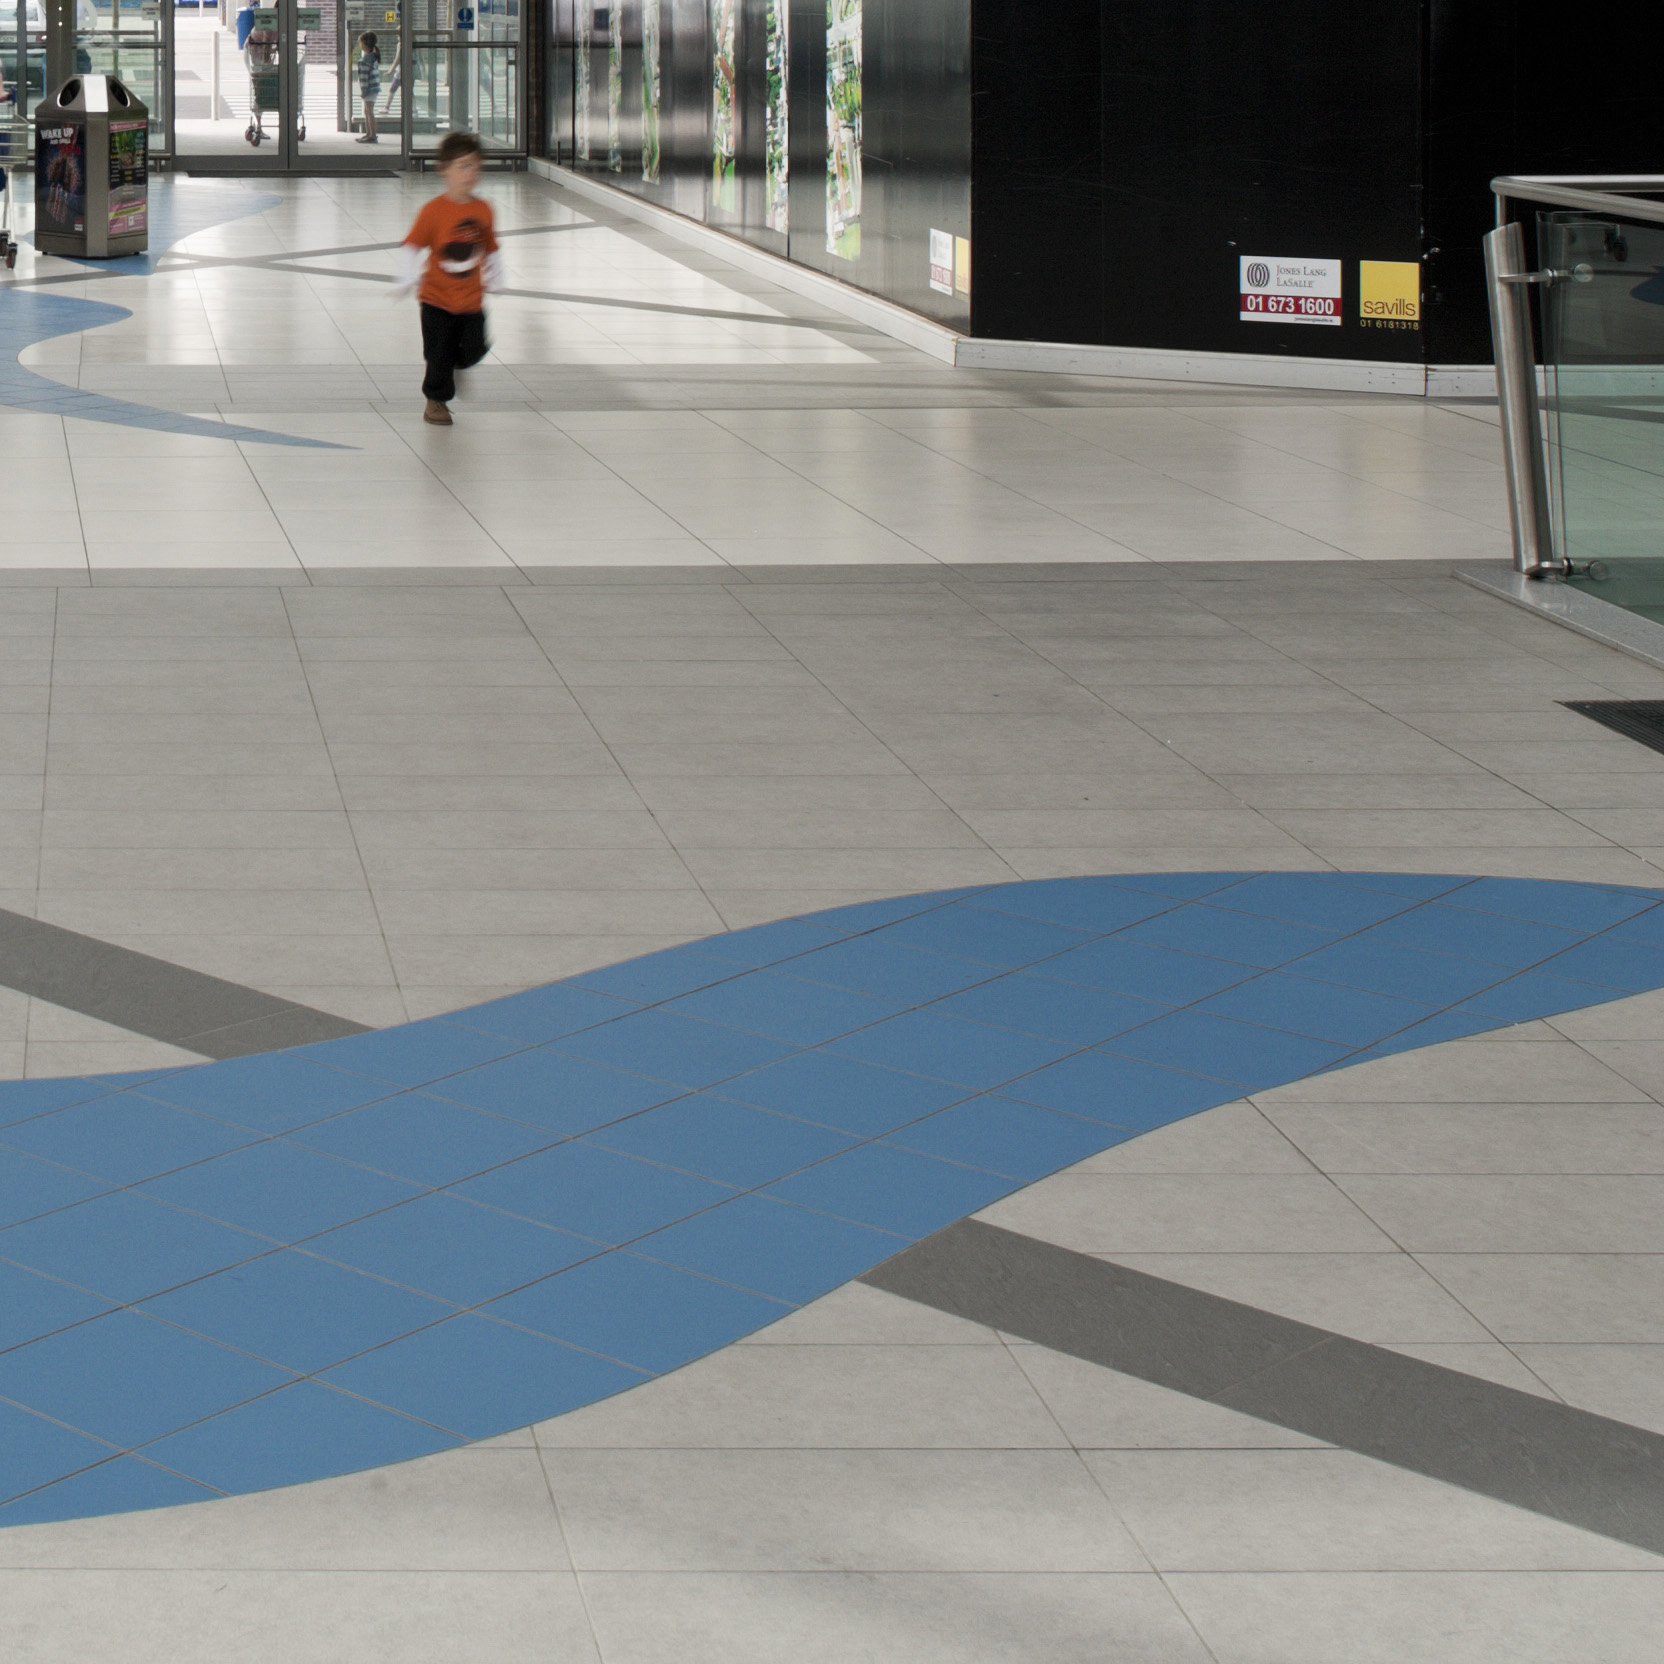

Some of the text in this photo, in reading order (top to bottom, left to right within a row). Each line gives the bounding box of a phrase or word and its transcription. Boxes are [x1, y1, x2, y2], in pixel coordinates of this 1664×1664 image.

[40, 127, 74, 140] WAKE UP
[1247, 295, 1334, 315] 01 673 1600
[1363, 298, 1416, 317] savills
[1360, 319, 1371, 328] 01
